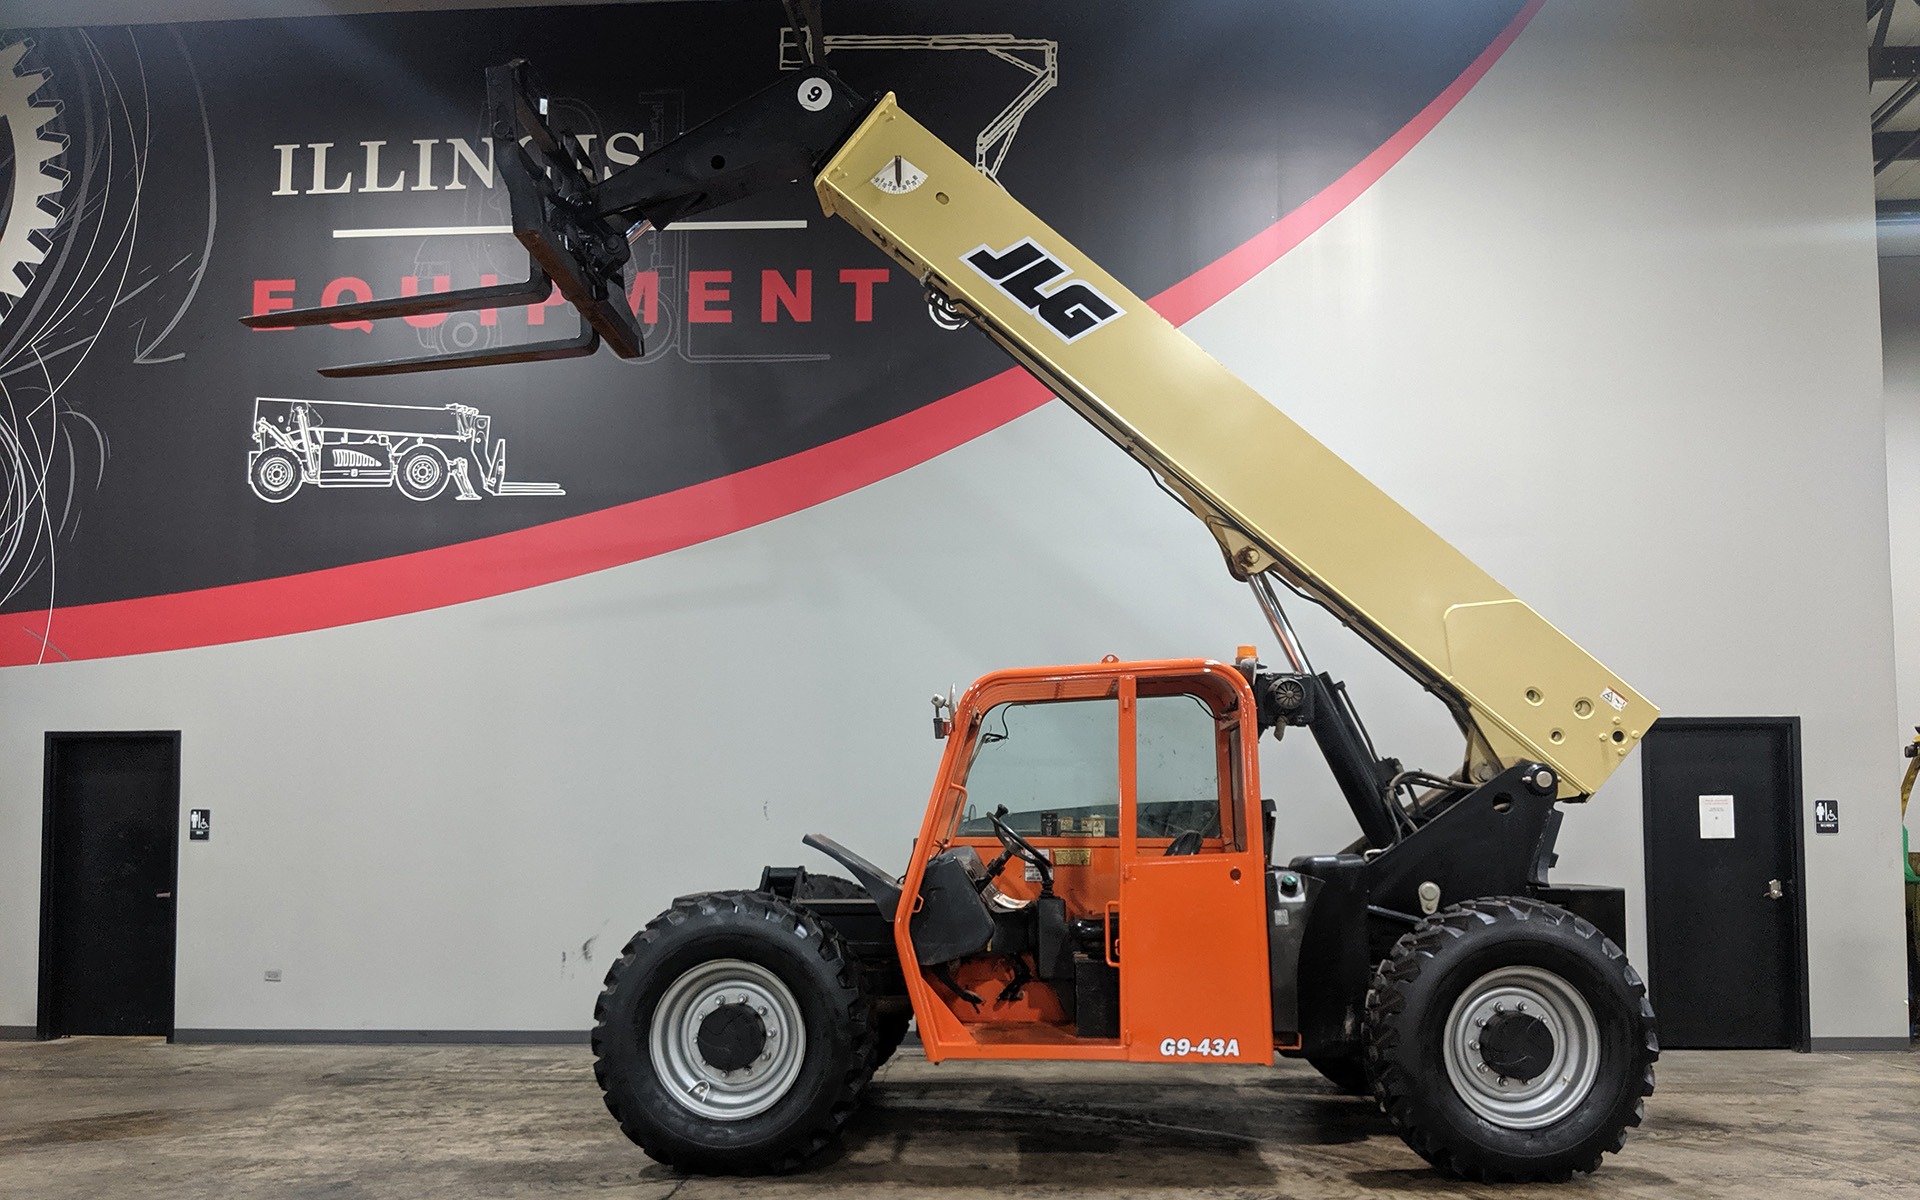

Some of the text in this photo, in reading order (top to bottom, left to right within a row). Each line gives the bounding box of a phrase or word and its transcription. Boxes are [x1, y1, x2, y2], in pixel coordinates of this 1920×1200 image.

[807, 85, 823, 103] 9
[272, 132, 644, 196] ILLINS
[962, 238, 1123, 342] JLG
[1160, 1037, 1240, 1057] G9-43A
